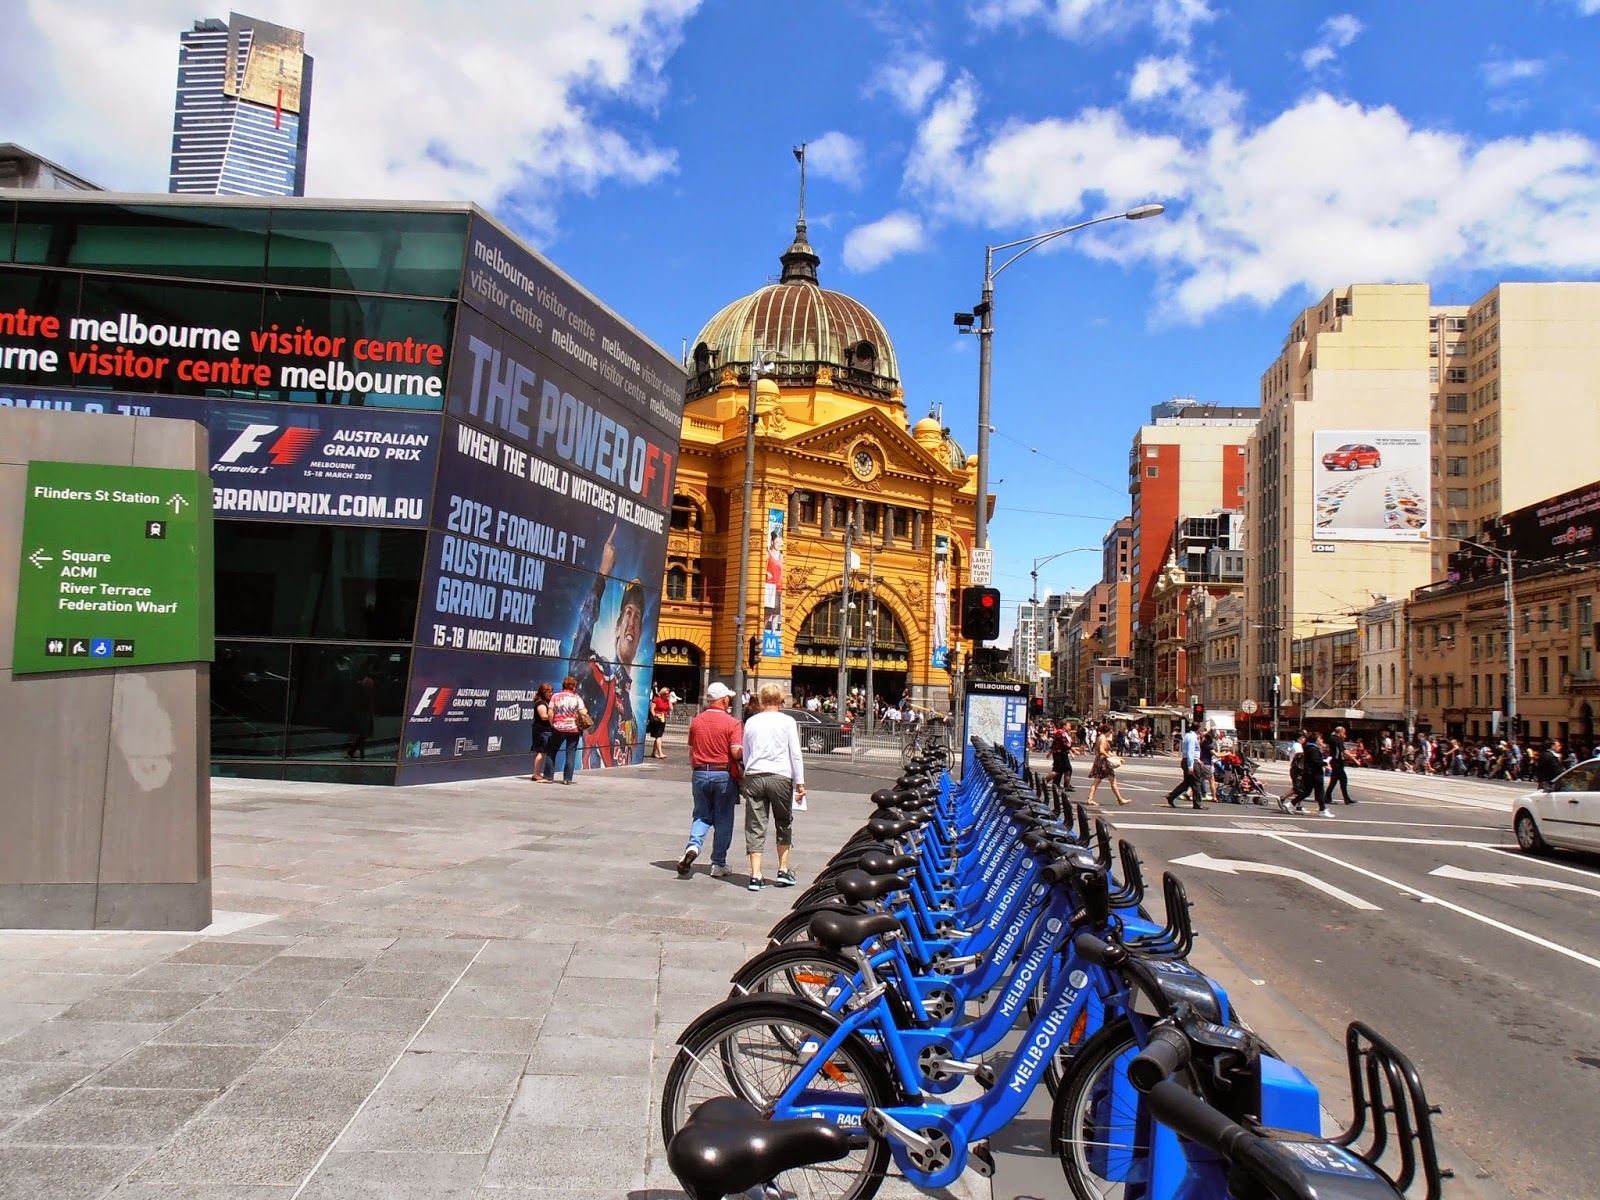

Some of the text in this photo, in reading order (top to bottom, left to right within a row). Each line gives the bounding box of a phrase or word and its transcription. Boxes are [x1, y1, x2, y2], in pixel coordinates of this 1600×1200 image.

[69, 313, 240, 351] melbourne
[251, 324, 346, 358] visitor
[353, 337, 444, 366] centre
[475, 239, 681, 406] melbourne visitor centre melbourne visitor centre
[471, 269, 681, 428] visitor centre melbourne visitor centre melbourne
[68, 344, 169, 379] visitor
[177, 356, 271, 387] centre
[280, 361, 442, 397] melbourne
[468, 335, 536, 441] THE
[537, 379, 630, 488] POWER
[323, 444, 421, 461] GRAND PRIX
[333, 429, 429, 446] AUSTRALIAN
[210, 463, 259, 474] Formula
[303, 470, 323, 478] 15-18
[325, 471, 353, 479] MARCH
[310, 461, 356, 470] MELBOURNE
[457, 424, 664, 535] WHEN THE WORLD WATCHES MELBOURNE
[34, 486, 160, 504] Flinders St Station
[213, 487, 423, 520] GRANDPRIX.COM.AU
[447, 495, 492, 540] 2012
[495, 510, 567, 562] FORMULA
[60, 566, 97, 578] ACMI
[62, 550, 111, 565] Square
[440, 535, 546, 591] AUSTRALIAN
[59, 599, 177, 613] Federation Wharf
[60, 582, 151, 596] River Terrace
[436, 576, 536, 625] GRAND PRIX
[116, 644, 132, 652] ATM
[467, 629, 503, 652] MARCH
[504, 633, 539, 655] ALBERT
[539, 638, 562, 657] PARK
[453, 699, 487, 707] GRAND PRIX
[457, 689, 490, 697] AUSTRALIAN
[974, 683, 1014, 691] MELBOURNE
[979, 822, 1007, 866] MELBOURNE
[981, 833, 1012, 883] MELBOURNE
[985, 848, 1020, 902] MELBOURNE
[987, 867, 1028, 930] MELBOURNE
[991, 894, 1038, 966] MELBOURNE
[999, 931, 1055, 1017] MELBOURNE
[1009, 986, 1078, 1093] MELBOURNE
